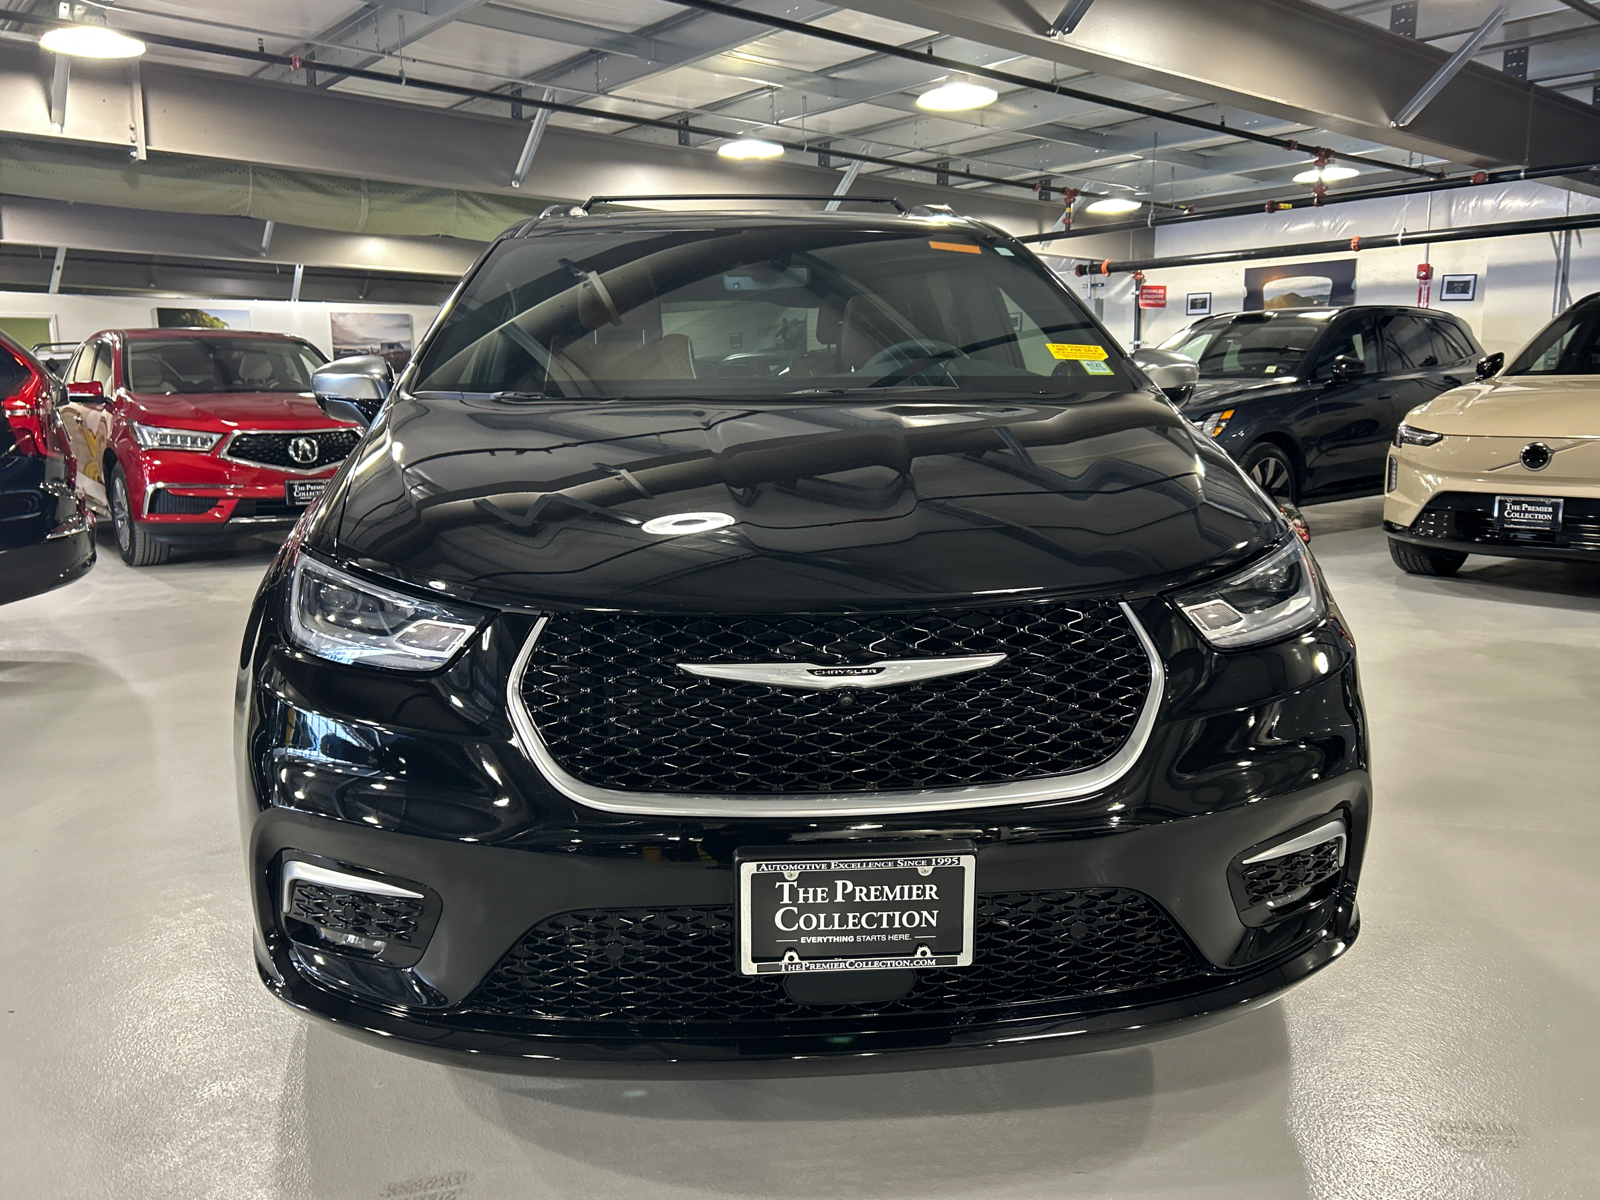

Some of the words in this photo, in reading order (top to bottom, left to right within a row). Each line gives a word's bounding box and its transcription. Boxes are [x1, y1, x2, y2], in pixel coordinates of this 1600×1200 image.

[1505, 503, 1520, 511] THE
[1521, 503, 1553, 512] PREMIER
[1504, 509, 1553, 520] COLLECTION
[813, 668, 877, 676] CHRYSLER
[758, 862, 828, 872] AUTOMOTIVE
[830, 860, 897, 870] EXCELLENCE
[897, 858, 927, 867] SINCE
[931, 857, 959, 866] 1995
[775, 881, 829, 904] THE
[834, 879, 939, 903] PREMIER
[774, 906, 939, 931] COLLECTION
[800, 935, 854, 943] EVERYTHING
[856, 934, 887, 942] STARTS
[887, 933, 912, 941] HERE.
